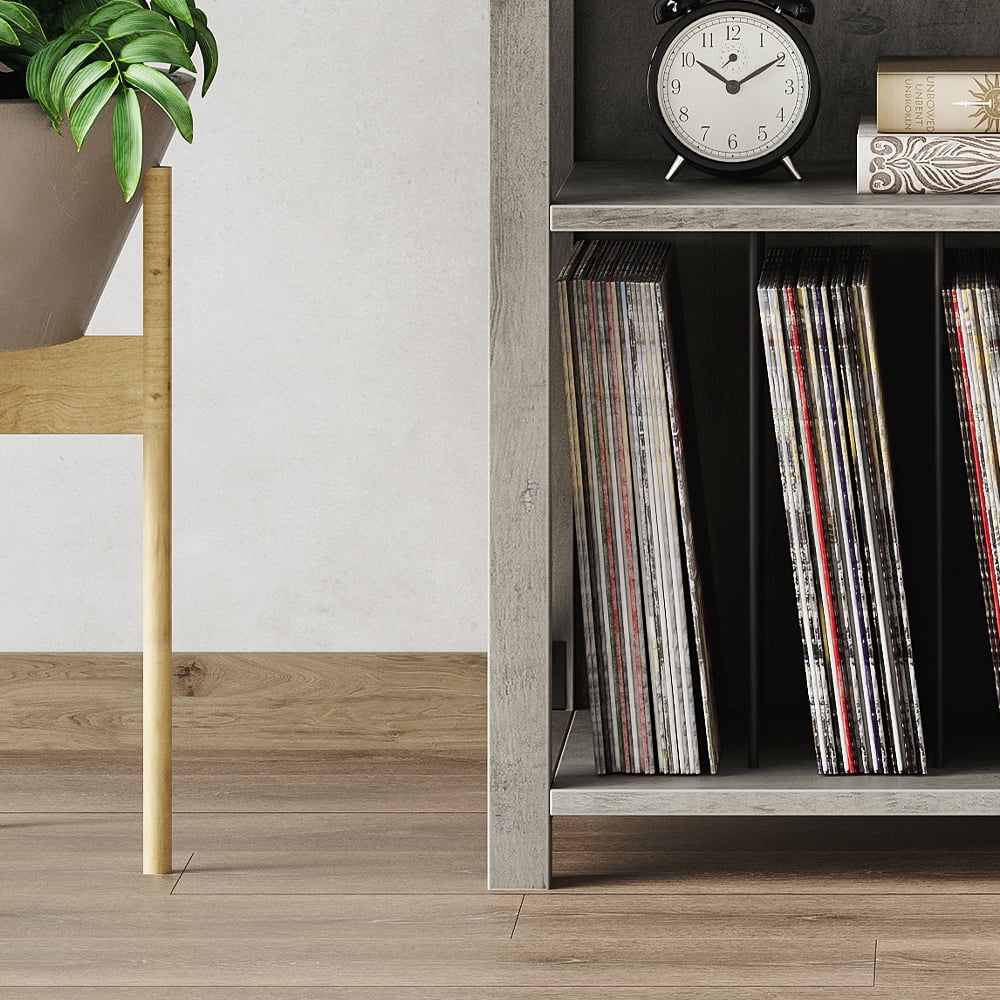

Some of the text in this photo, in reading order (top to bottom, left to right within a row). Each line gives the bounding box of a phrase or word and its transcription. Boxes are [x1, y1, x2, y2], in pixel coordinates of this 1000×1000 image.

[702, 32, 713, 48] 11
[725, 25, 741, 41] 12
[758, 32, 764, 48] 1
[681, 52, 696, 67] 10
[776, 52, 786, 67] 2
[671, 79, 681, 95] 9
[784, 79, 795, 95] 3
[904, 78, 912, 130] UNBROKEN
[914, 83, 924, 126] UNBENT
[926, 76, 936, 132] UNBOWED
[679, 106, 689, 122] 8
[775, 106, 785, 122] 4
[701, 126, 711, 141] 7
[757, 126, 768, 141] 5
[728, 134, 738, 150] 6
